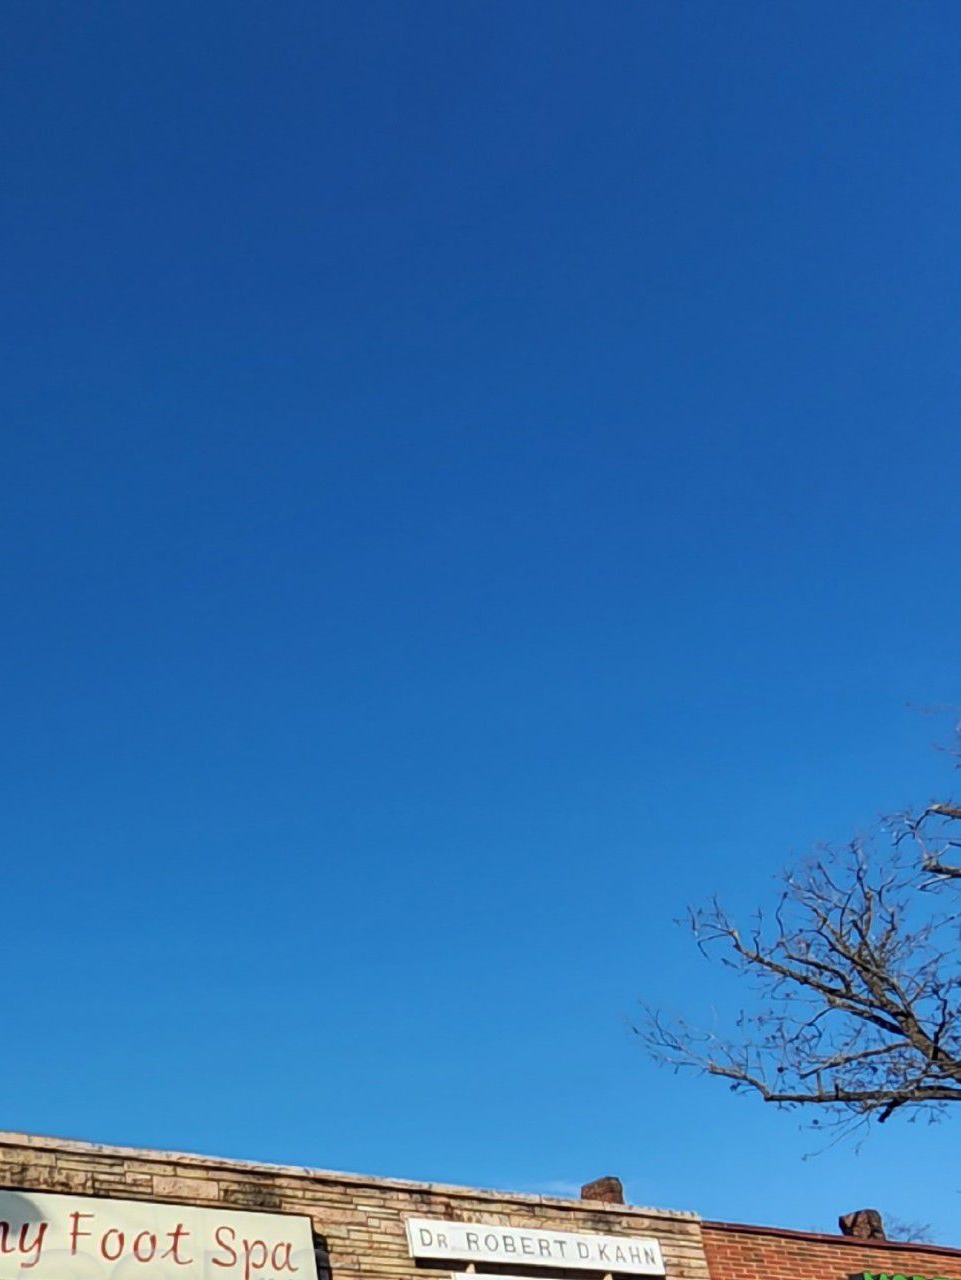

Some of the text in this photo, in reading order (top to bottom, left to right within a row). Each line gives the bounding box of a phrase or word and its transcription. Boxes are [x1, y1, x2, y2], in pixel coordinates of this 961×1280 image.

[69, 1211, 193, 1265] Foot
[211, 1225, 299, 1280] Spa
[466, 1231, 568, 1259] ROBERT
[597, 1243, 657, 1266] KAHN
